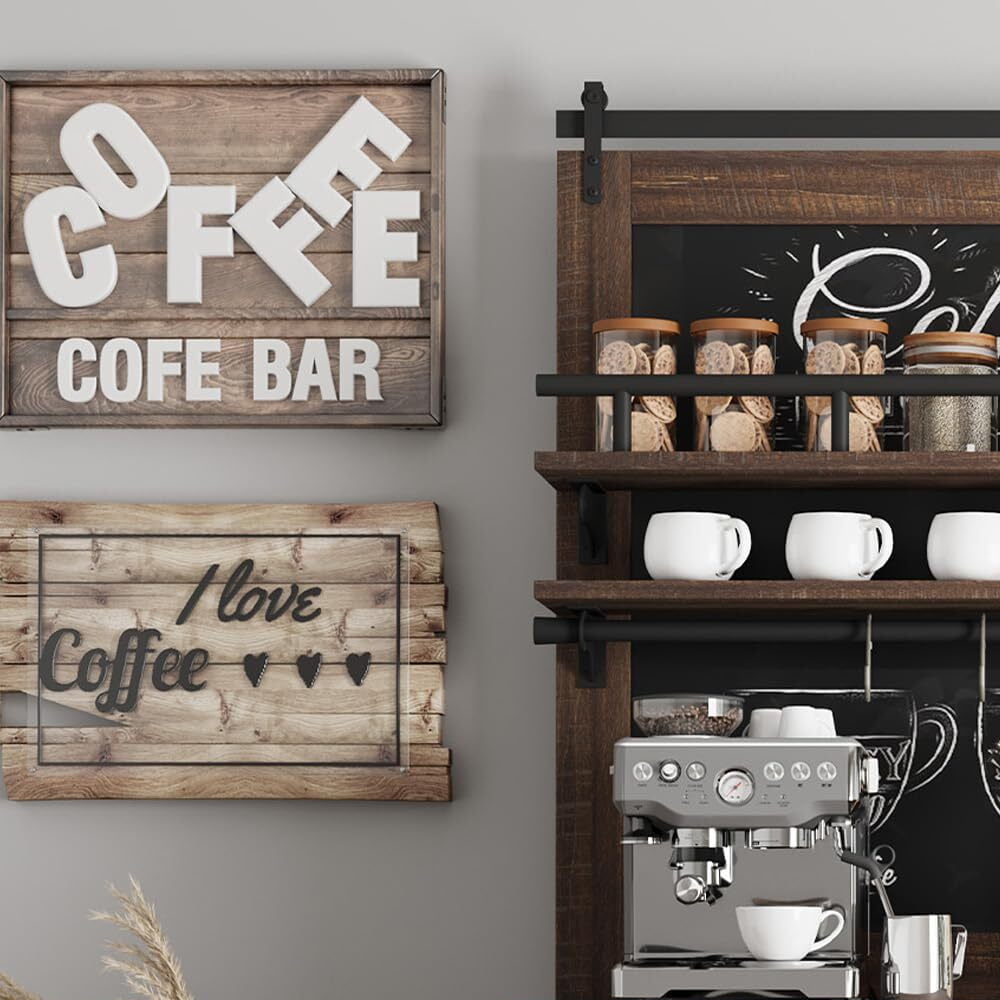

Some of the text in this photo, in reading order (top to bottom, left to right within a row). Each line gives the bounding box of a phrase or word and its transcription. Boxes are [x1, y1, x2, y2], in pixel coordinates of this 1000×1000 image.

[57, 338, 384, 403] COFE BAR
[176, 559, 322, 625] I love
[39, 628, 210, 712] Coffee
